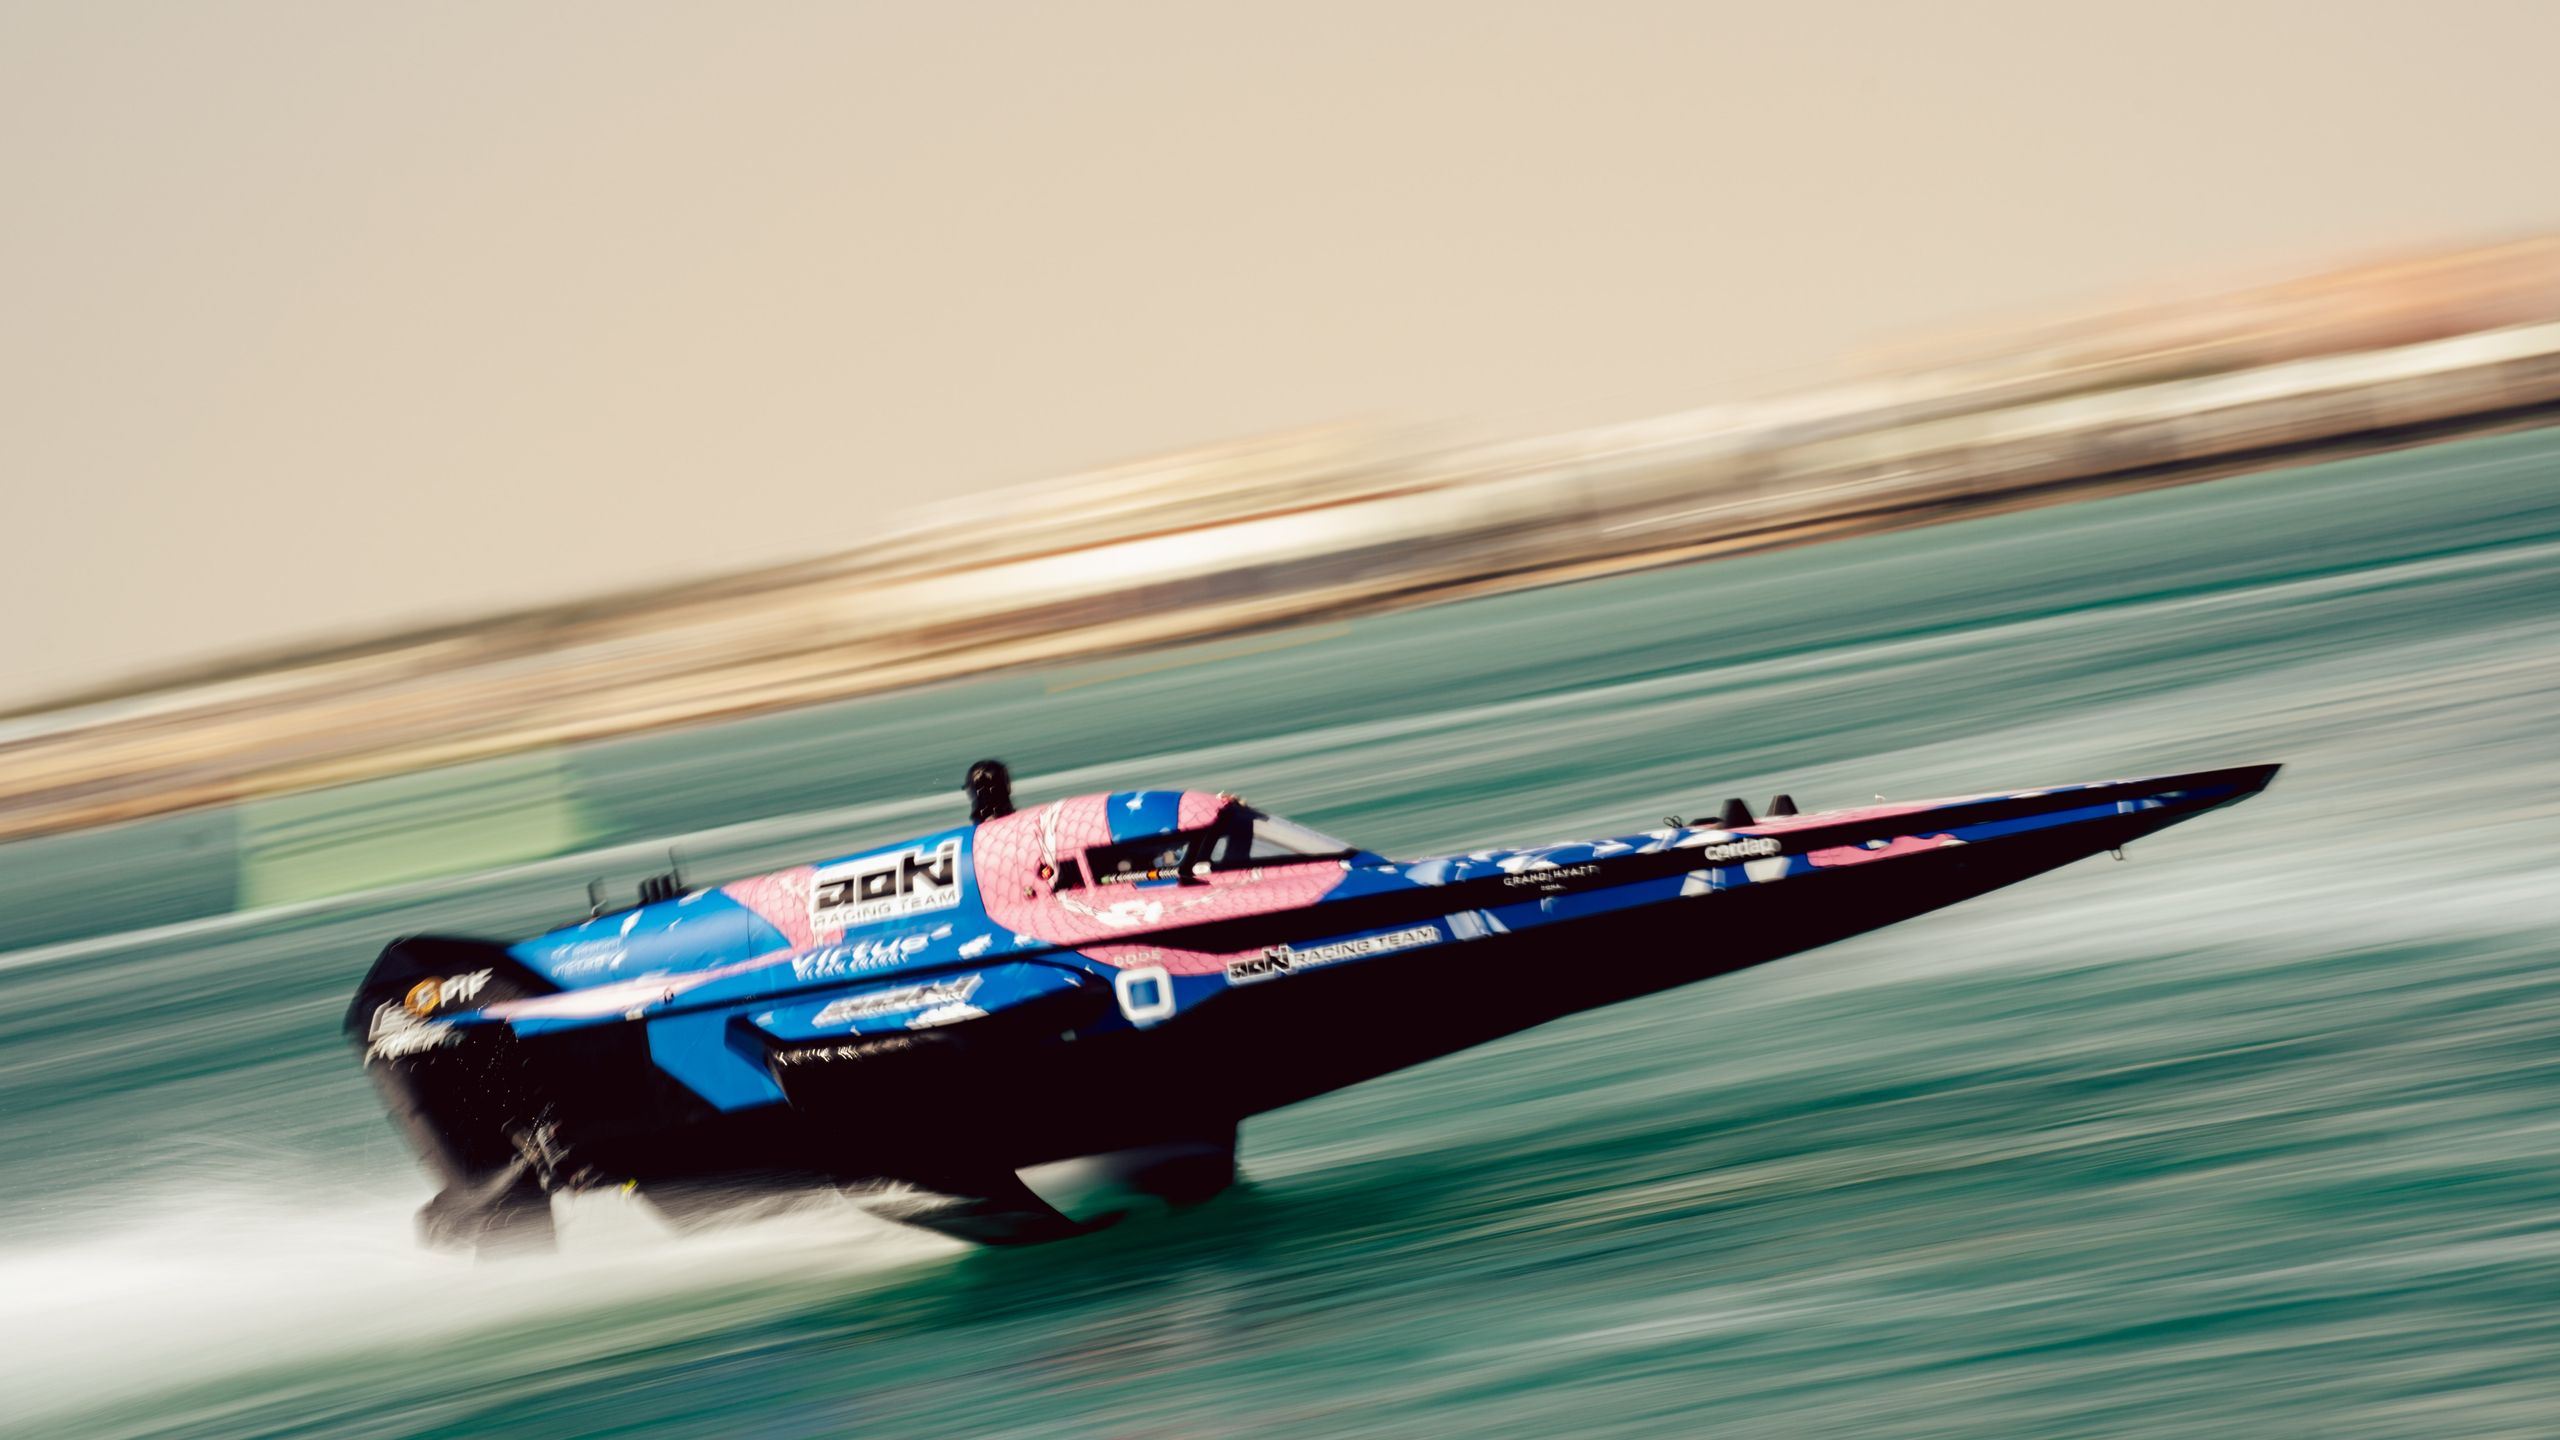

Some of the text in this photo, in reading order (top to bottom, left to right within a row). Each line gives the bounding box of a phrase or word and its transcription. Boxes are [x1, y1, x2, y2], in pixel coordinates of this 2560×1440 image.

[1503, 865, 1599, 887] GRAND HYATT
[814, 891, 956, 928] RACING TEAM
[1293, 940, 1371, 964] RACING
[1377, 928, 1435, 946] TEAM
